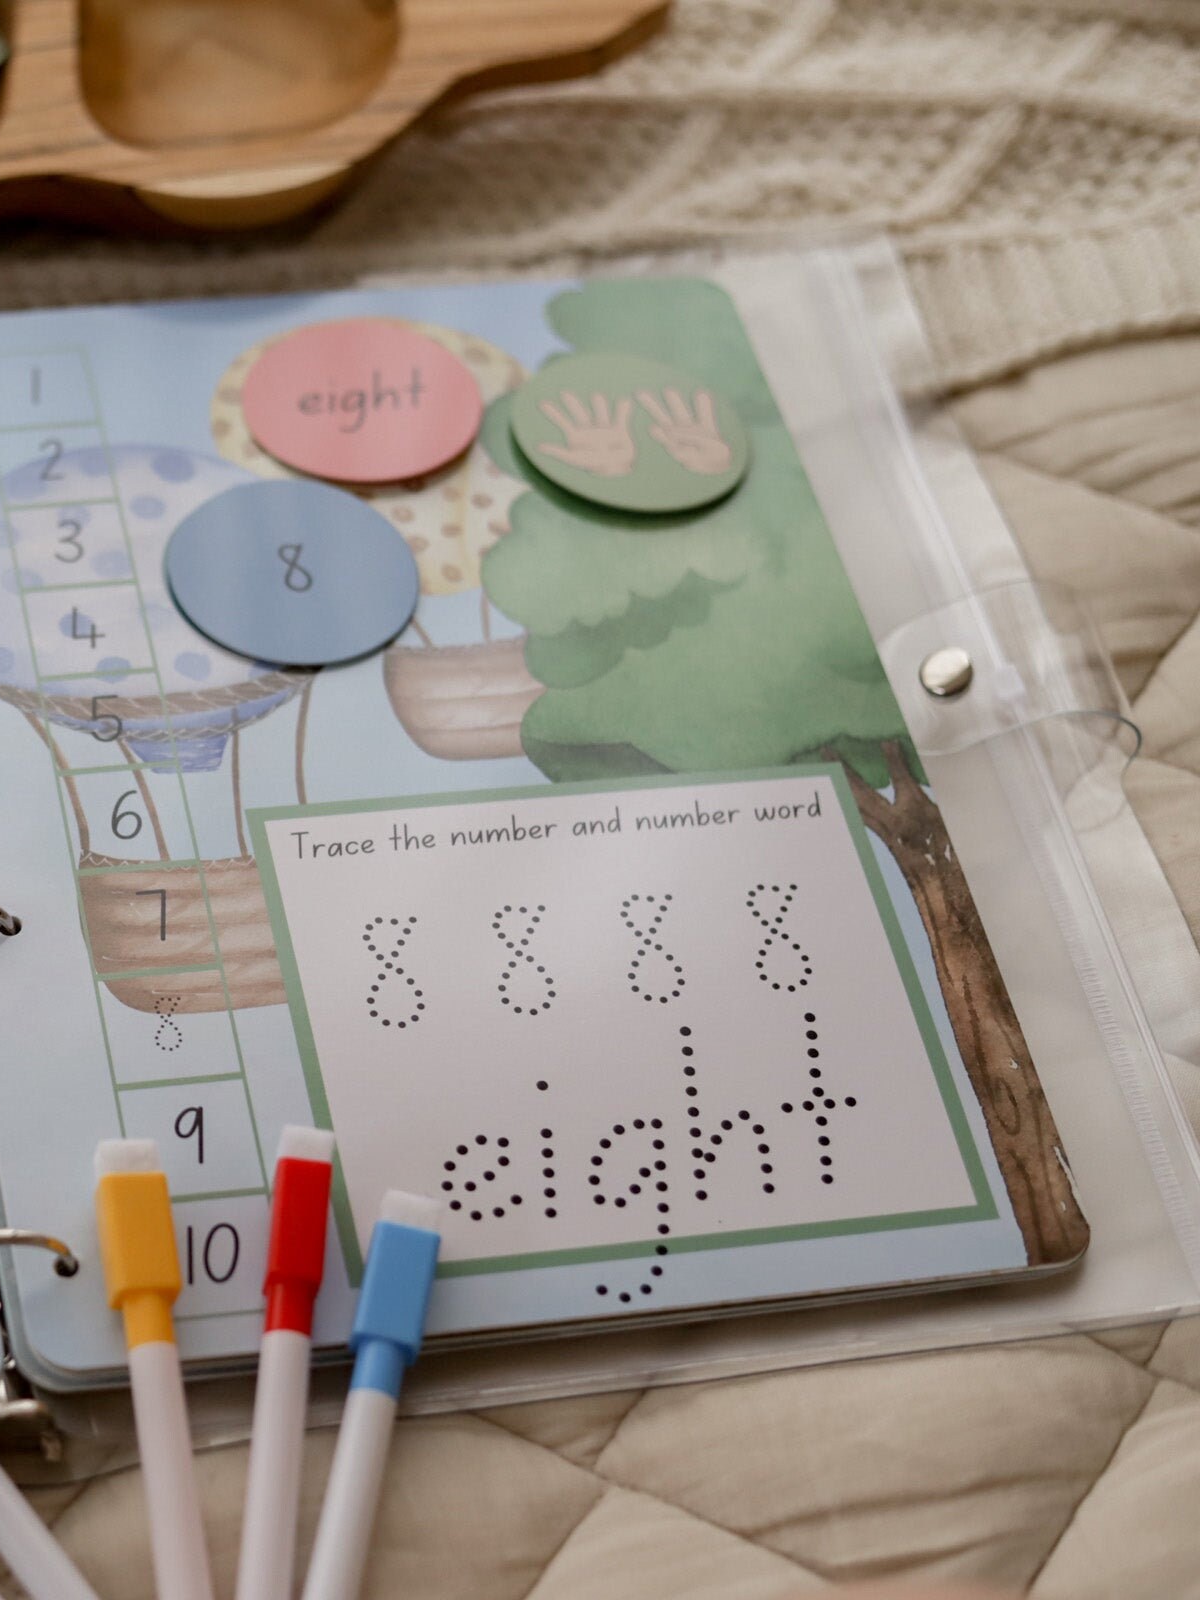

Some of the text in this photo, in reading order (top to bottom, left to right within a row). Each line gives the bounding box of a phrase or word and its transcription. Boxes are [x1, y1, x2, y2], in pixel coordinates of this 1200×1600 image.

[30, 367, 41, 405] 1
[297, 368, 424, 434] eight
[39, 439, 64, 482] 2
[54, 518, 85, 564] 3
[277, 543, 314, 593] 8
[70, 606, 106, 649] 4
[91, 694, 123, 743] 5
[111, 789, 143, 840] 6
[290, 794, 822, 860] Trace the number and number word
[134, 888, 167, 942] 7
[362, 884, 813, 1029] 8 8 8 8
[153, 996, 183, 1052] 8
[174, 1106, 204, 1165] 9
[440, 1011, 858, 1303] eight
[186, 1222, 240, 1286] 10
